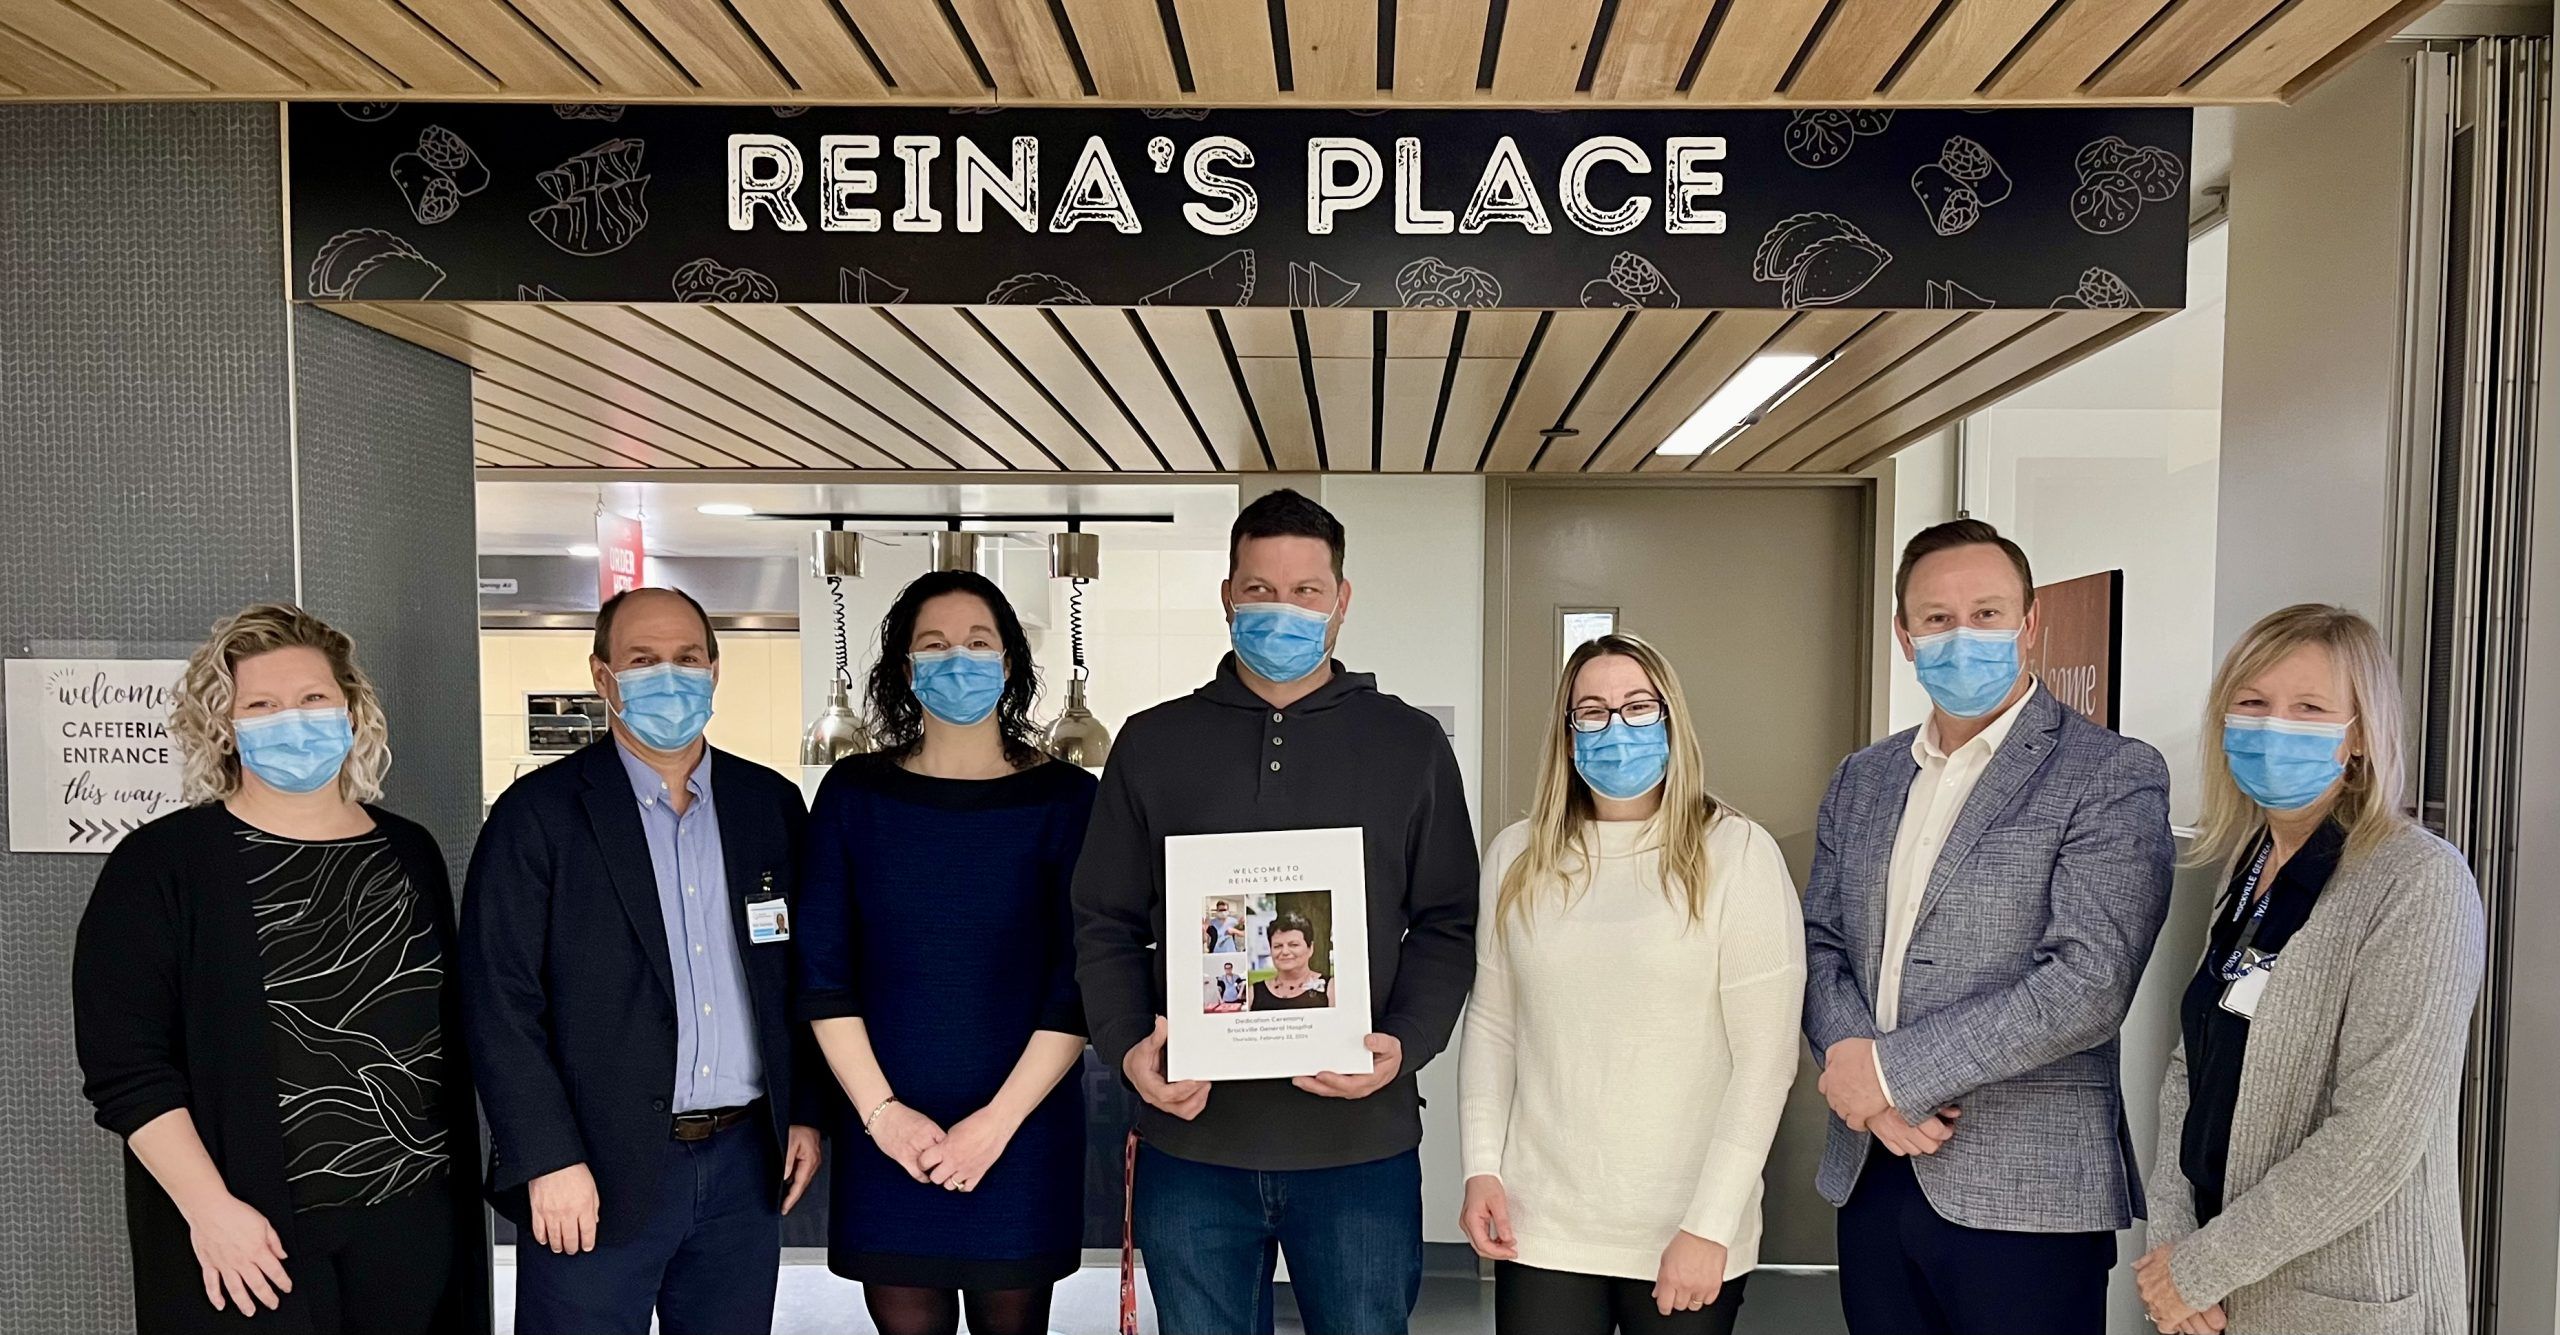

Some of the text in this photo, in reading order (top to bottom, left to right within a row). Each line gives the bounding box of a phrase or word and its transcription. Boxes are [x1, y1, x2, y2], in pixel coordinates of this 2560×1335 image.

[728, 133, 1727, 235] REINA'S PLACE
[609, 547, 635, 575] ORDER
[2030, 626, 2097, 716] lcome
[62, 721, 168, 738] CAFETERIA
[63, 747, 168, 763] ENTRANCE
[62, 770, 107, 805] this
[1228, 874, 1304, 885] REINA'S PLACE
[1233, 866, 1281, 874] WELCOME
